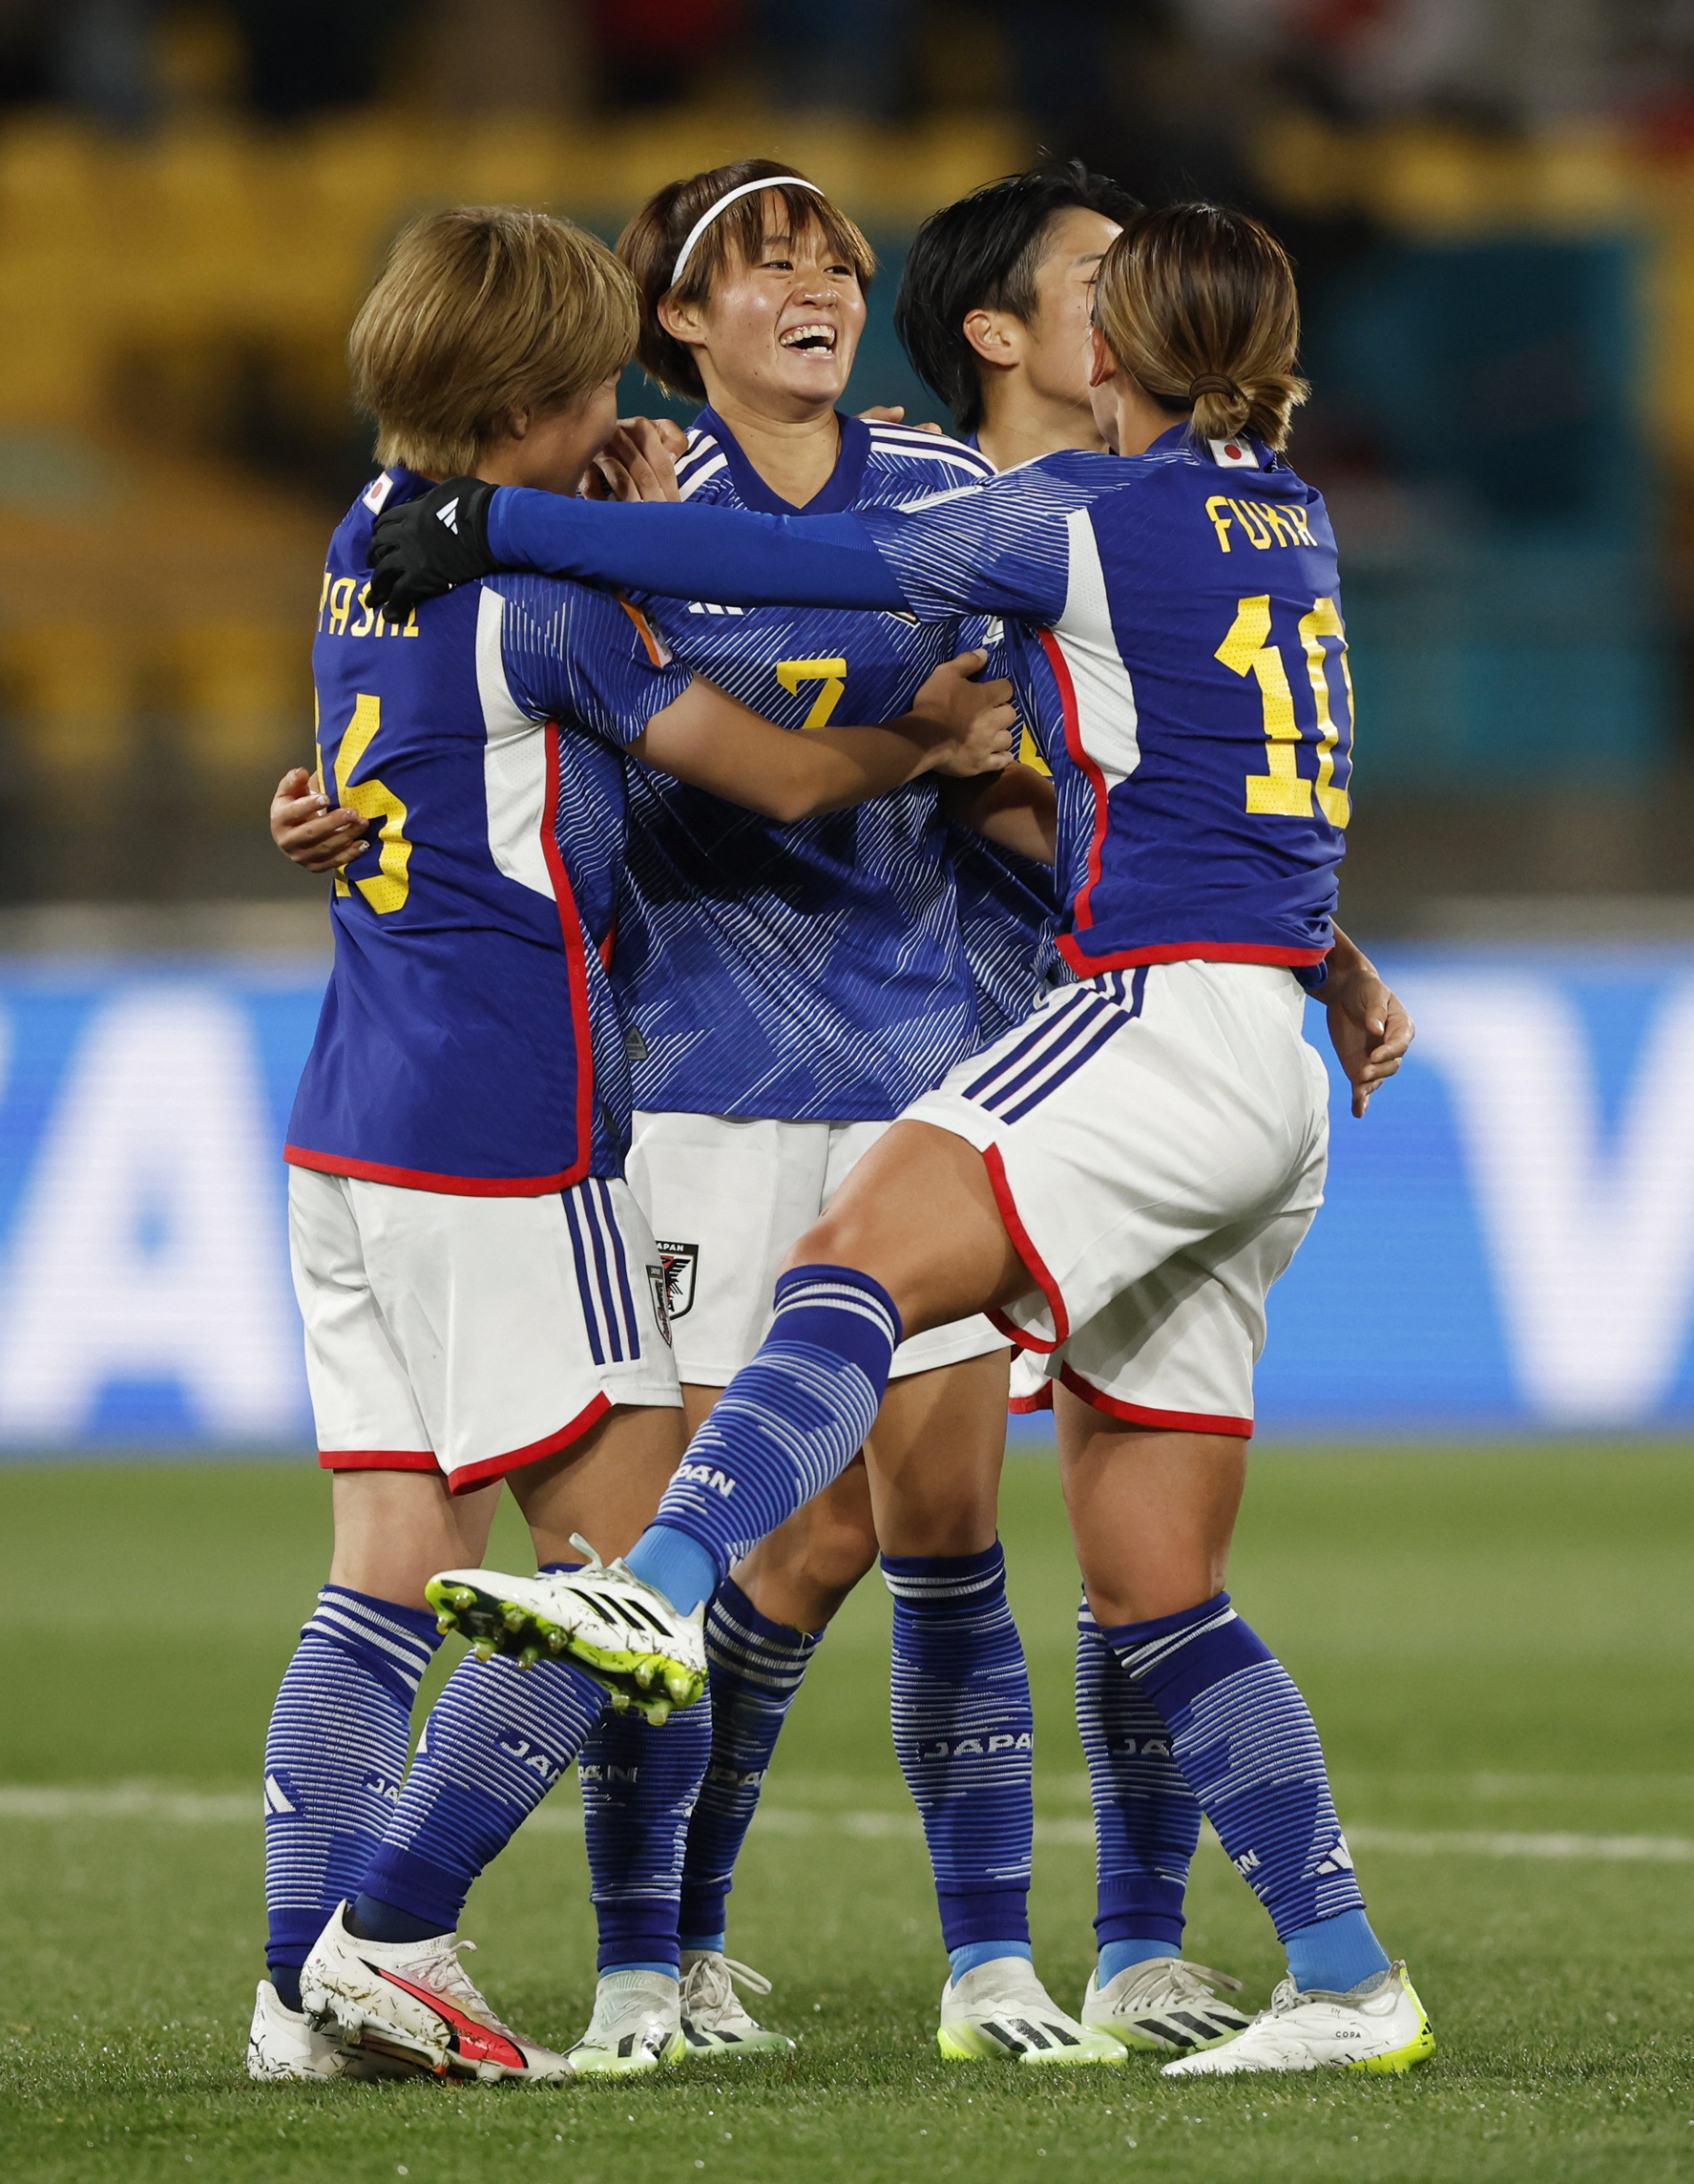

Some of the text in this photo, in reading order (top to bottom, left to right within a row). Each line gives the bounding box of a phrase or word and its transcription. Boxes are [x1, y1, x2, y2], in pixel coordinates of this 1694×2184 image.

[1204, 494, 1319, 554] FUKA
[776, 657, 847, 729] 7
[1213, 594, 1355, 830] 10
[656, 1242, 685, 1252] APAN
[923, 1732, 1035, 1758] JAPA
[1335, 2030, 1362, 2039] COPA
